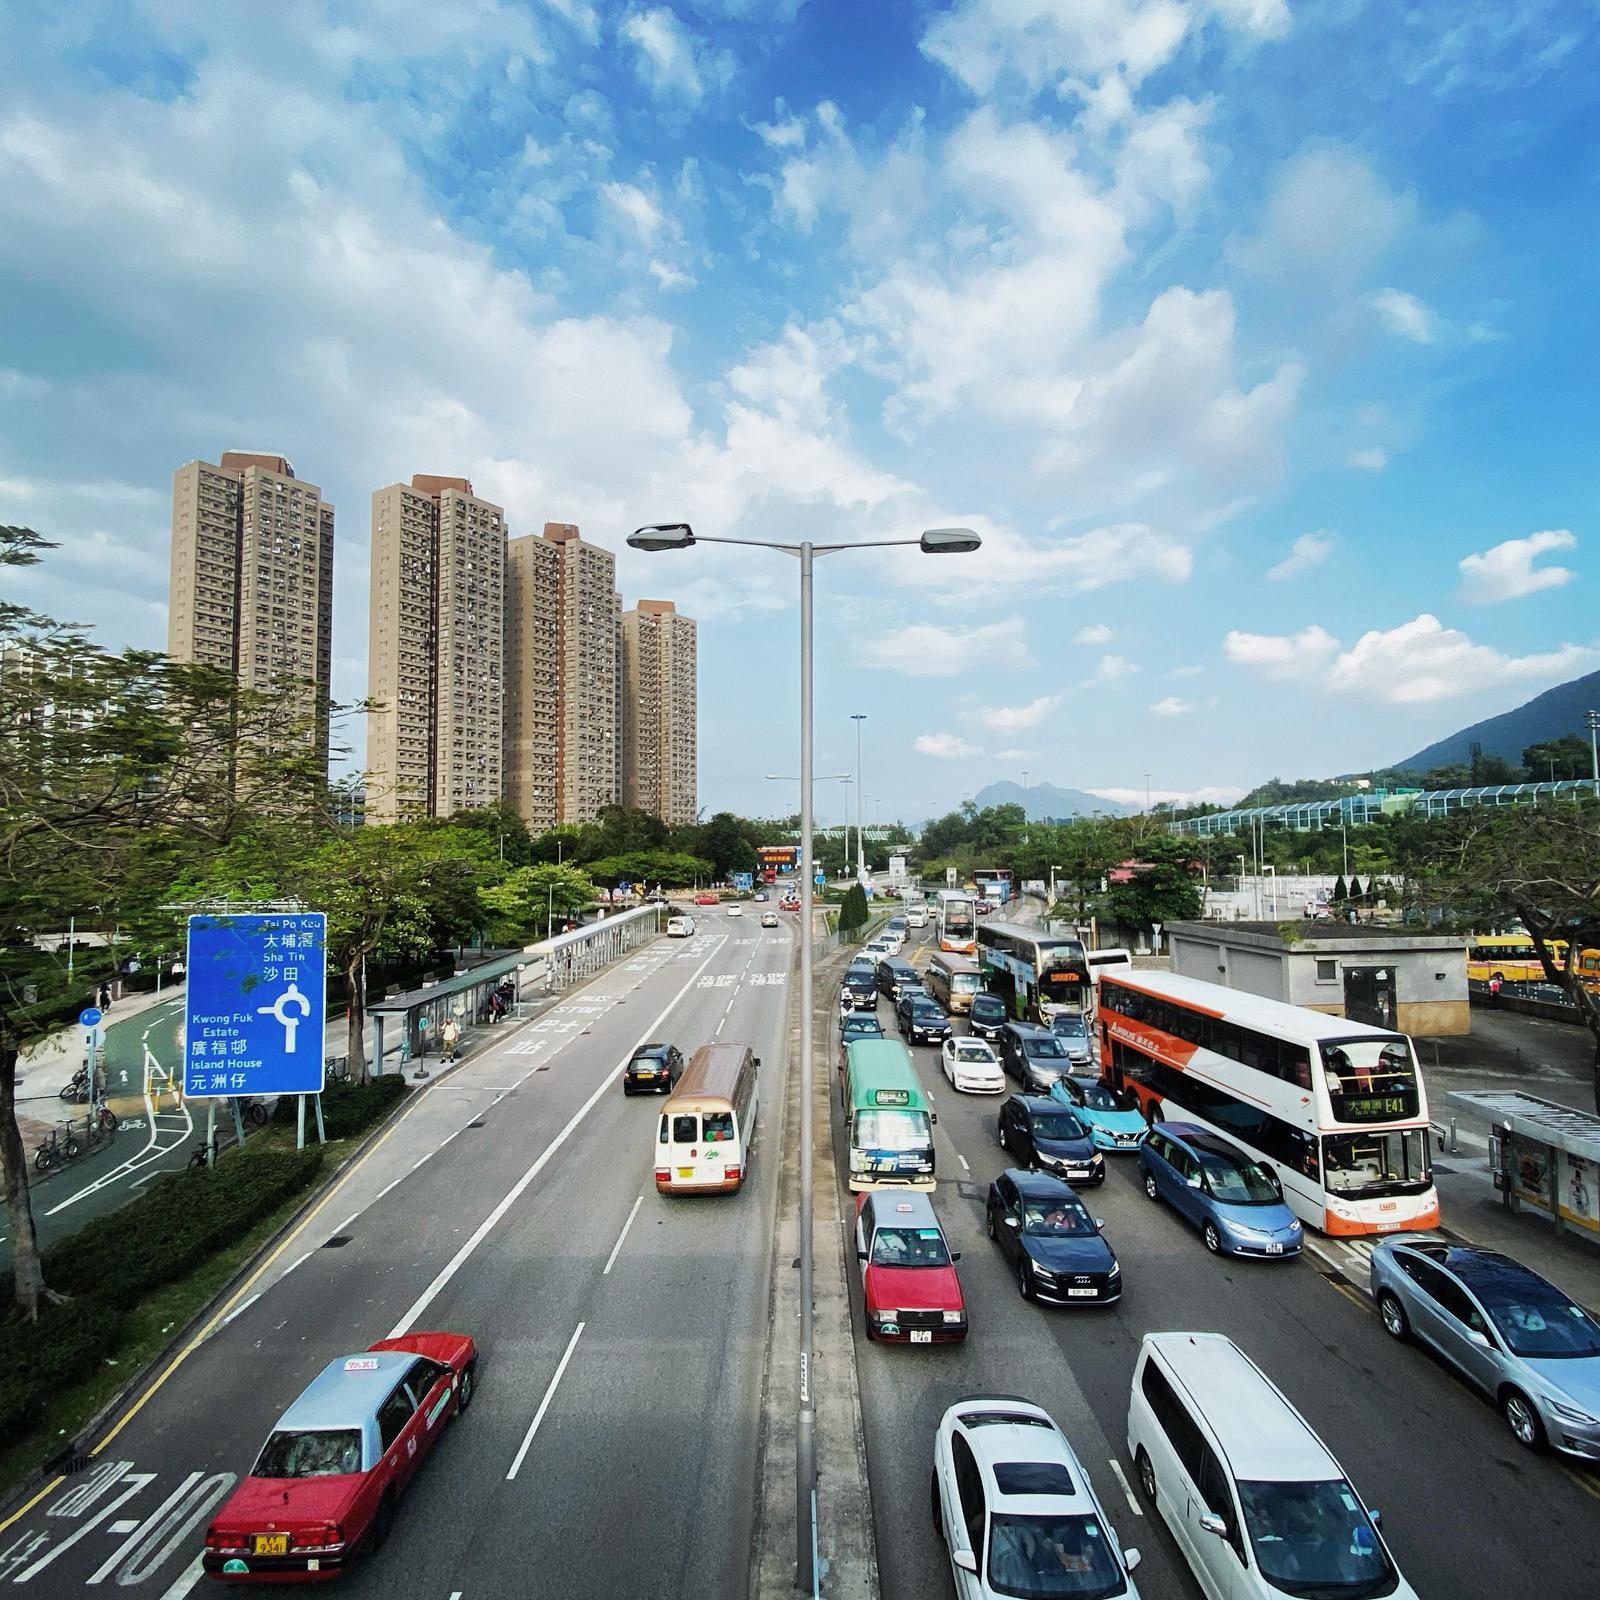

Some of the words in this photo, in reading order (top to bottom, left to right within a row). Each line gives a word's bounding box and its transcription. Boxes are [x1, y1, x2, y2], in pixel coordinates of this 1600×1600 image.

[283, 920, 297, 929] Po
[264, 952, 284, 962] Sha
[288, 951, 305, 961] Tin
[264, 966, 298, 981] 沙田
[553, 1006, 602, 1014] STOP
[193, 1014, 230, 1024] Kwong
[233, 1013, 253, 1022] Fuk
[529, 1019, 580, 1032] 巴士
[203, 1027, 239, 1037] Estate
[191, 1039, 247, 1056] 廣福邨
[504, 1040, 548, 1055] 站
[191, 1060, 225, 1070] Island
[228, 1059, 263, 1069] House
[190, 1073, 247, 1090] 元洲仔
[1385, 1097, 1404, 1113] E41
[347, 1360, 375, 1369] TAXI
